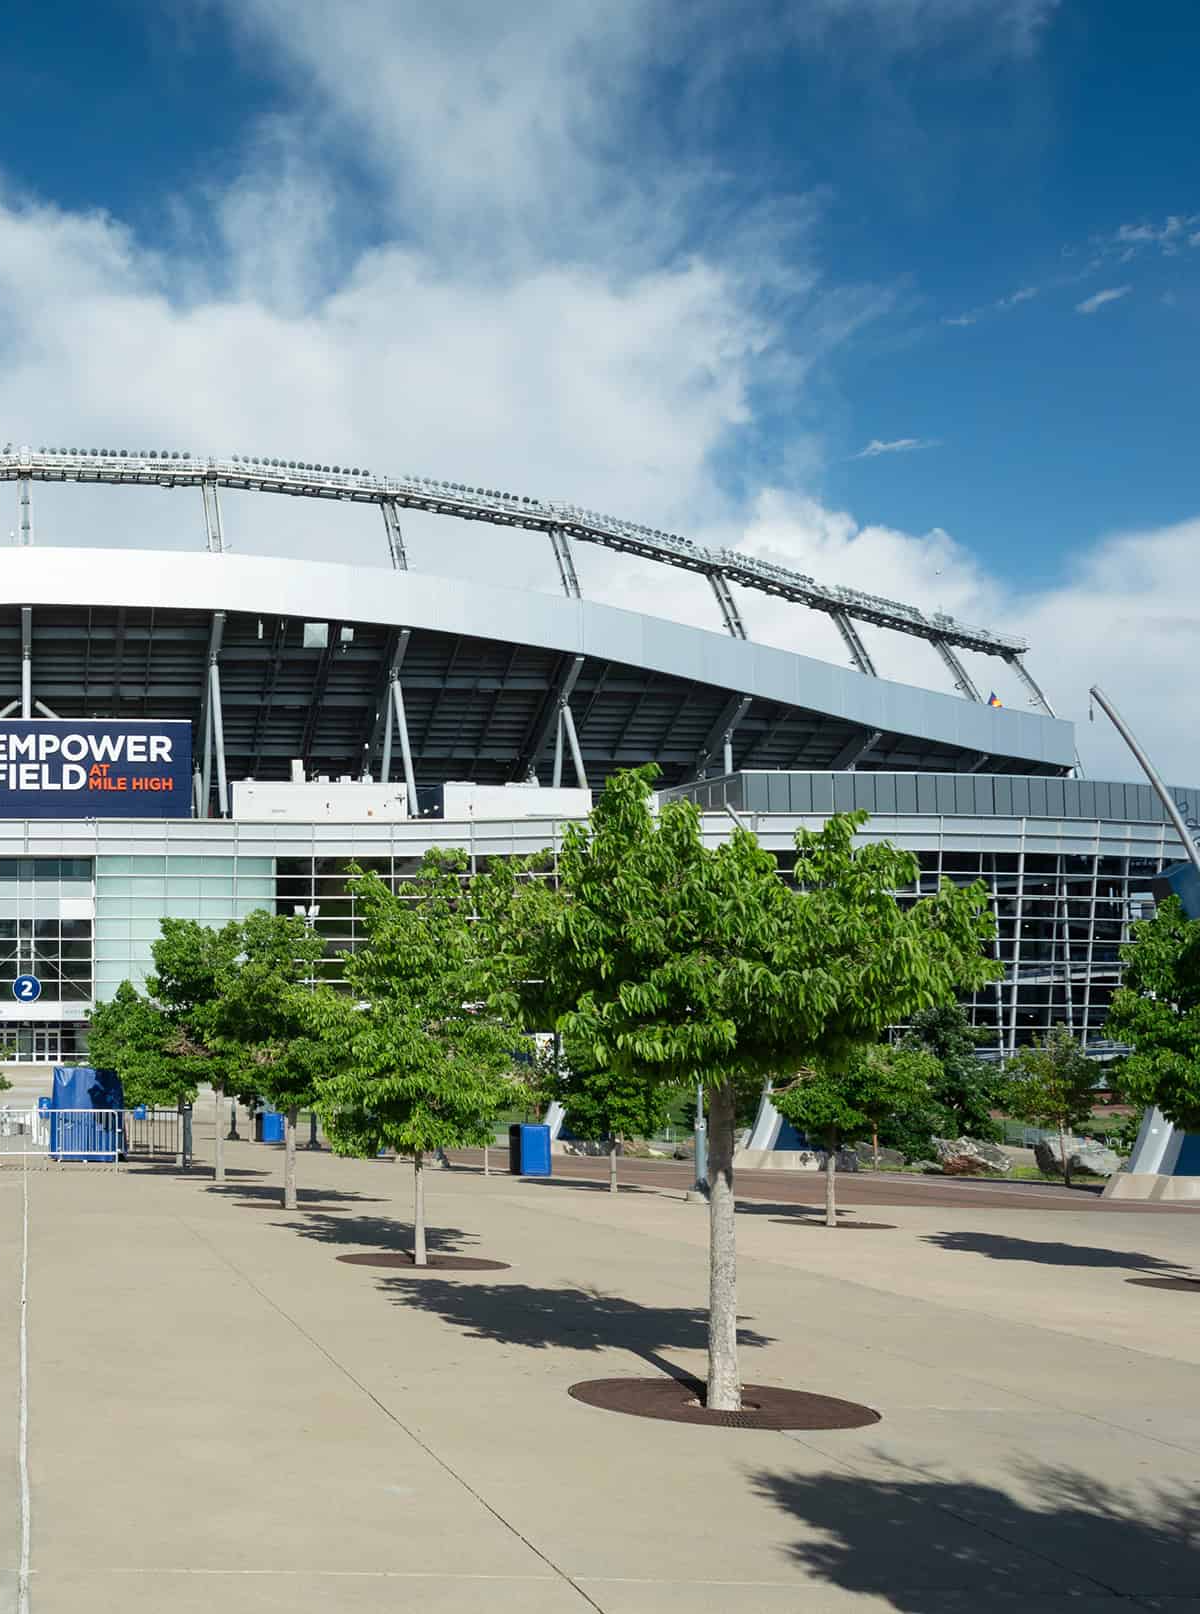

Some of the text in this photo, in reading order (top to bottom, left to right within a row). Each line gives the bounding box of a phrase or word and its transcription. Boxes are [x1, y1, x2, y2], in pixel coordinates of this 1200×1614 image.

[90, 763, 111, 776] AT
[89, 778, 173, 790] MILE HIGH
[21, 981, 33, 996] 2
